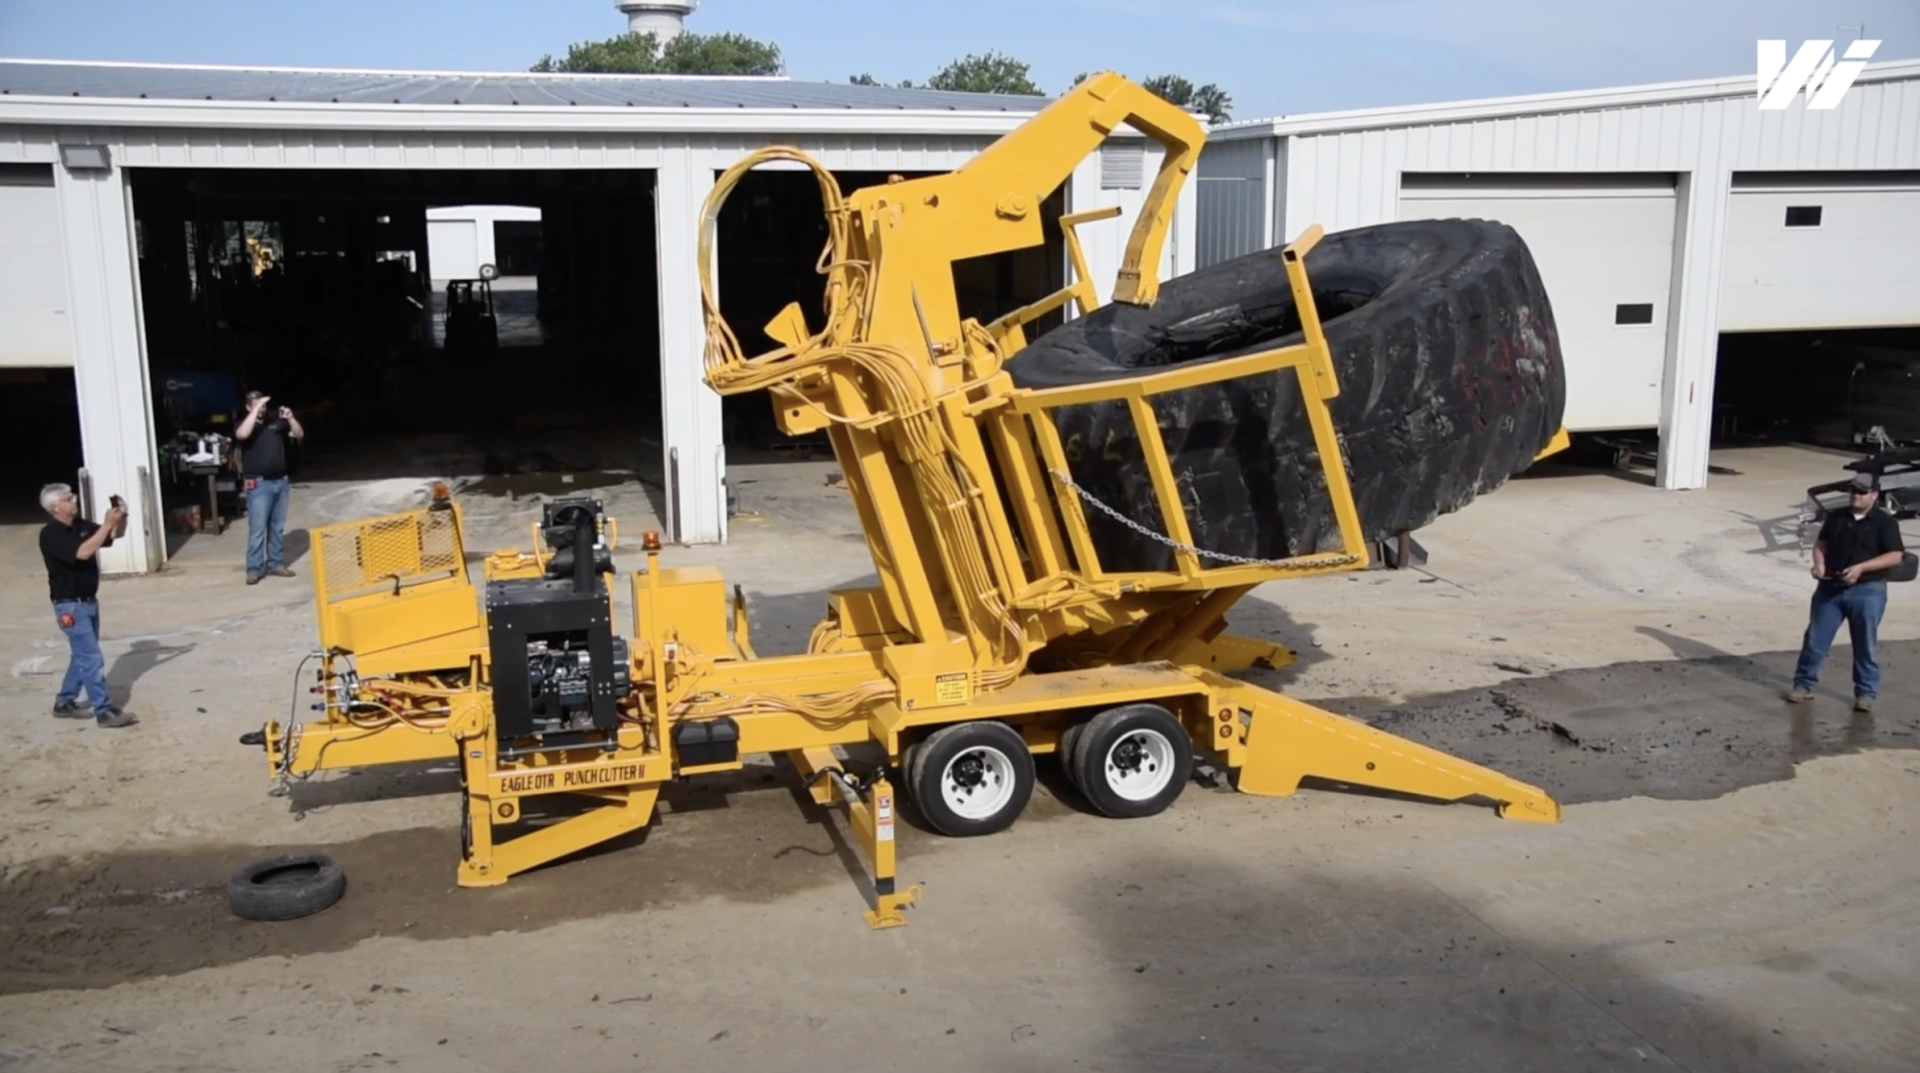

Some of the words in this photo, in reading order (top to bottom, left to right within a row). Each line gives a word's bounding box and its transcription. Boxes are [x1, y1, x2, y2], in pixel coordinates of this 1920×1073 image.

[501, 775, 533, 793] EAGLE
[534, 773, 555, 789] OTR
[564, 768, 597, 786] PUNCH
[599, 764, 637, 783] CUTTER
[638, 764, 646, 779] II
